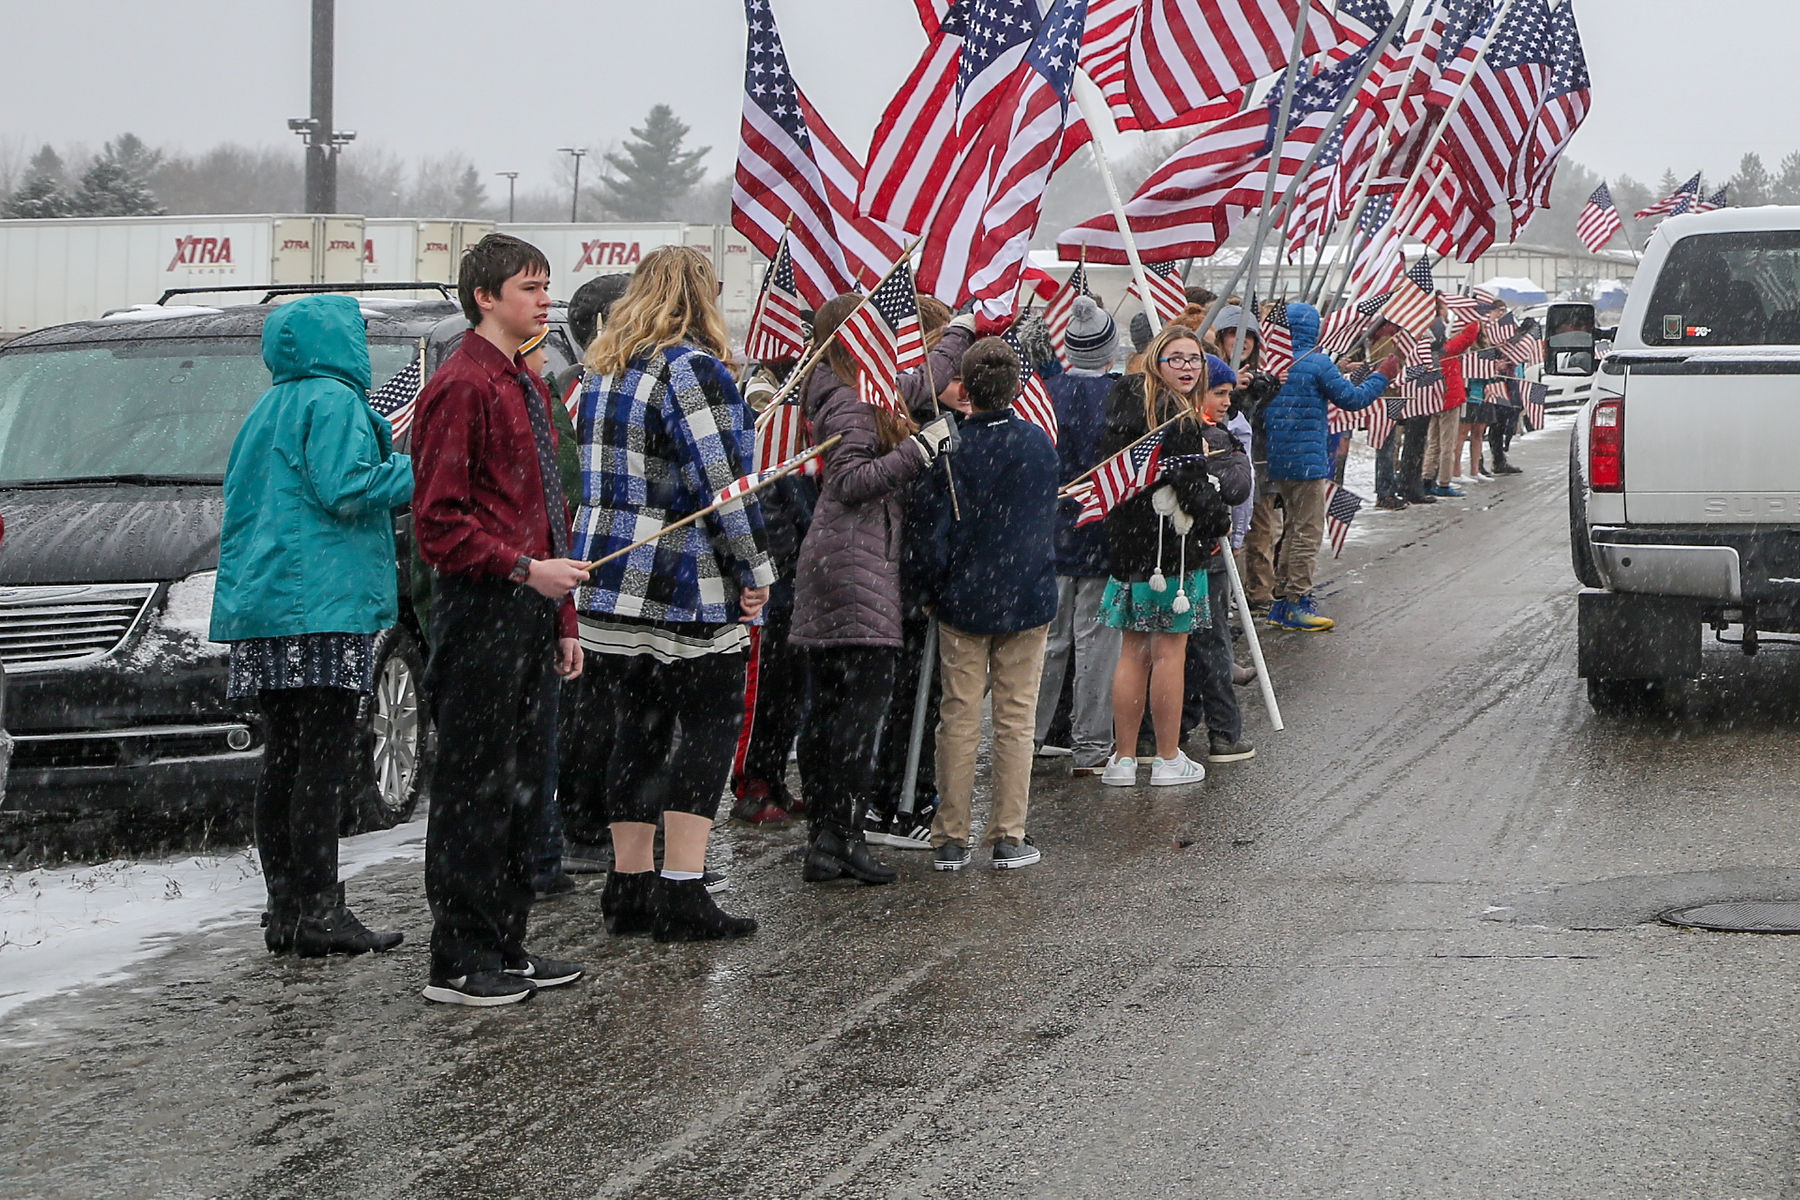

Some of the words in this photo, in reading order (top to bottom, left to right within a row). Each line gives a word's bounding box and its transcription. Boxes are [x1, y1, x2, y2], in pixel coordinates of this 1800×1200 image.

[166, 235, 232, 272] XTRA
[281, 240, 310, 251] XTRA
[327, 240, 356, 251] XTRA
[573, 239, 641, 273] XTRA
